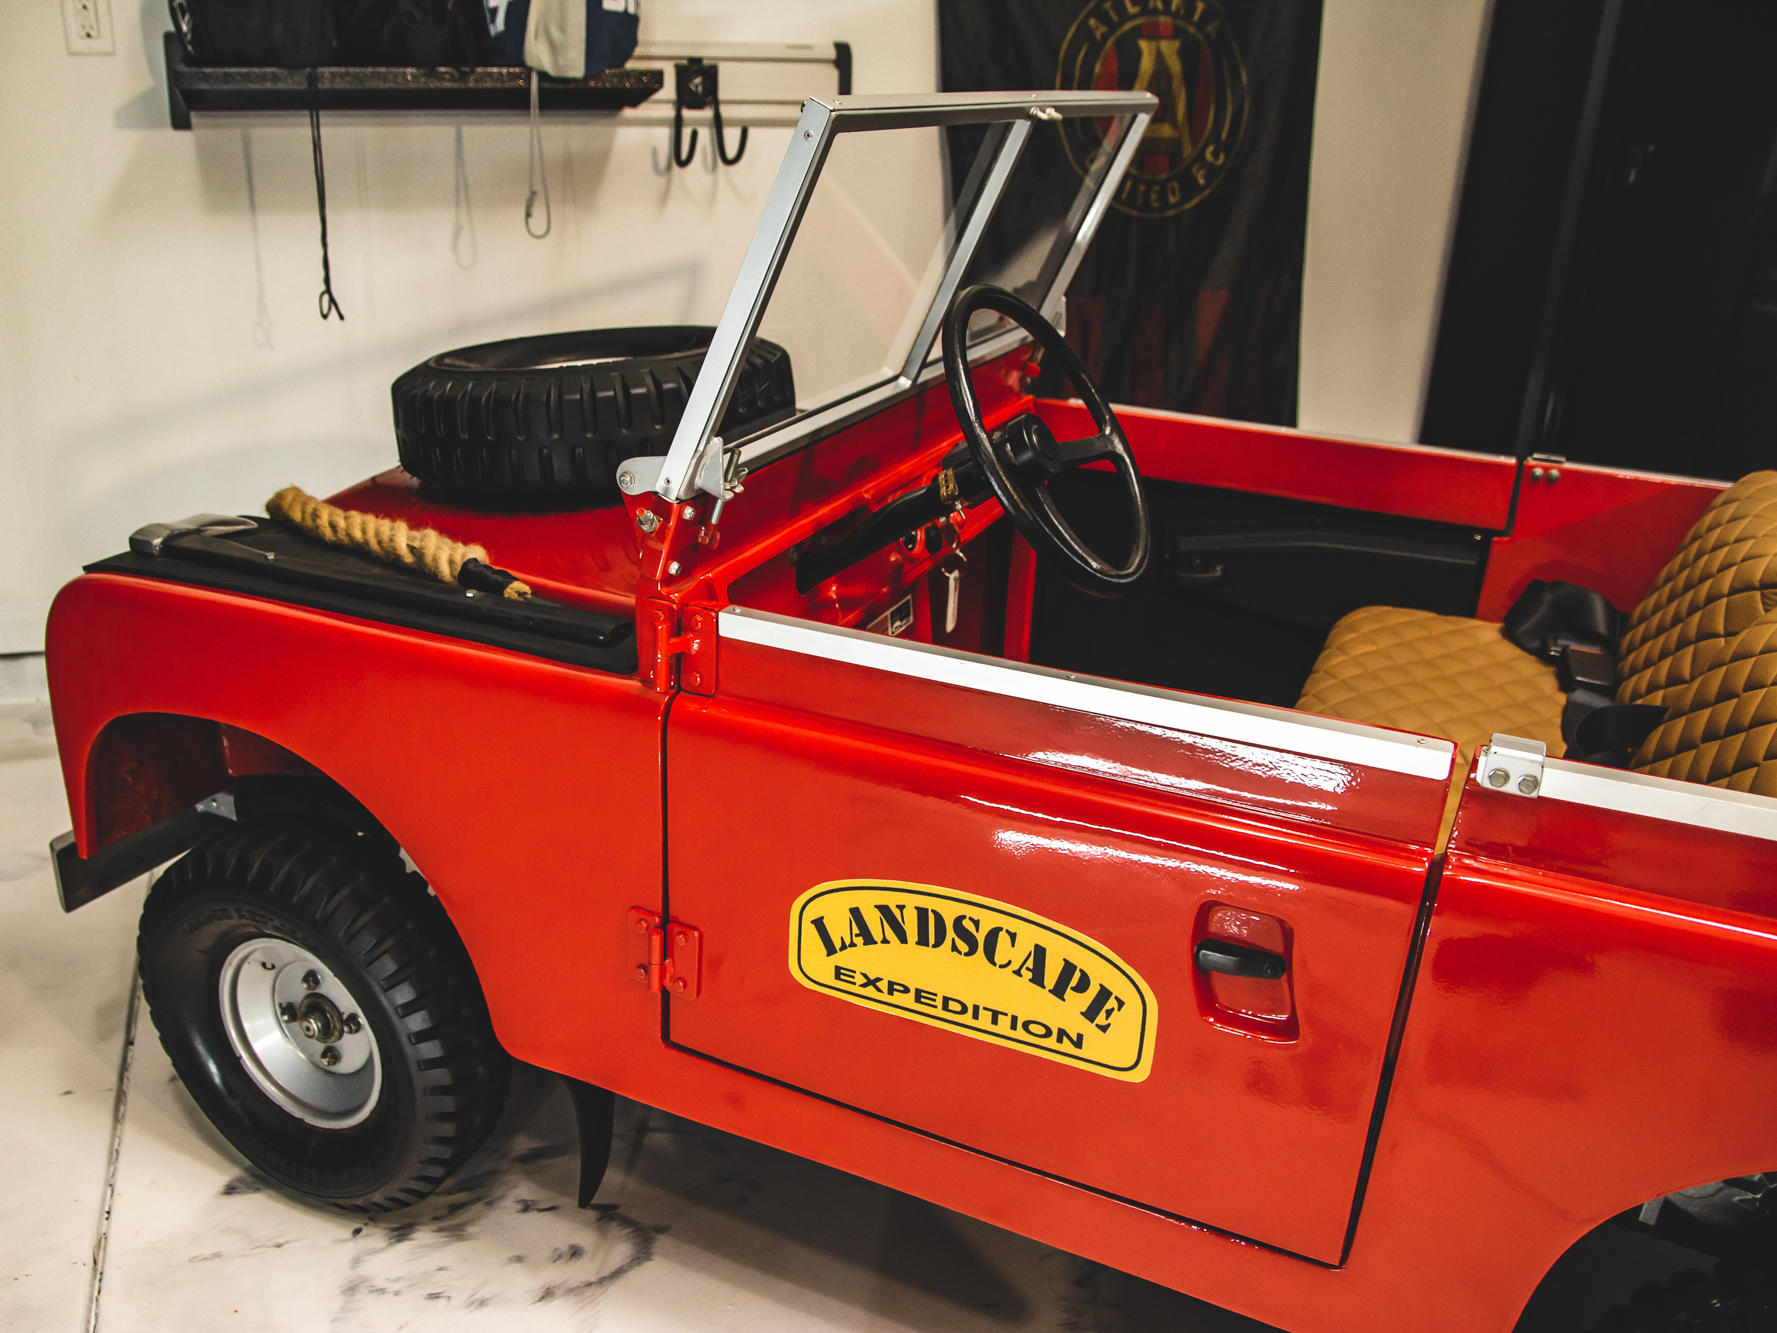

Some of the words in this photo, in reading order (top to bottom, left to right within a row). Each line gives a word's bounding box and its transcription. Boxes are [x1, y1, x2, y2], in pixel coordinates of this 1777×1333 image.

[1085, 147, 1182, 208] UITED
[1191, 144, 1226, 186] FC
[810, 904, 1126, 1034] LANDSCAPE
[834, 965, 1085, 1051] EXPEDITION
